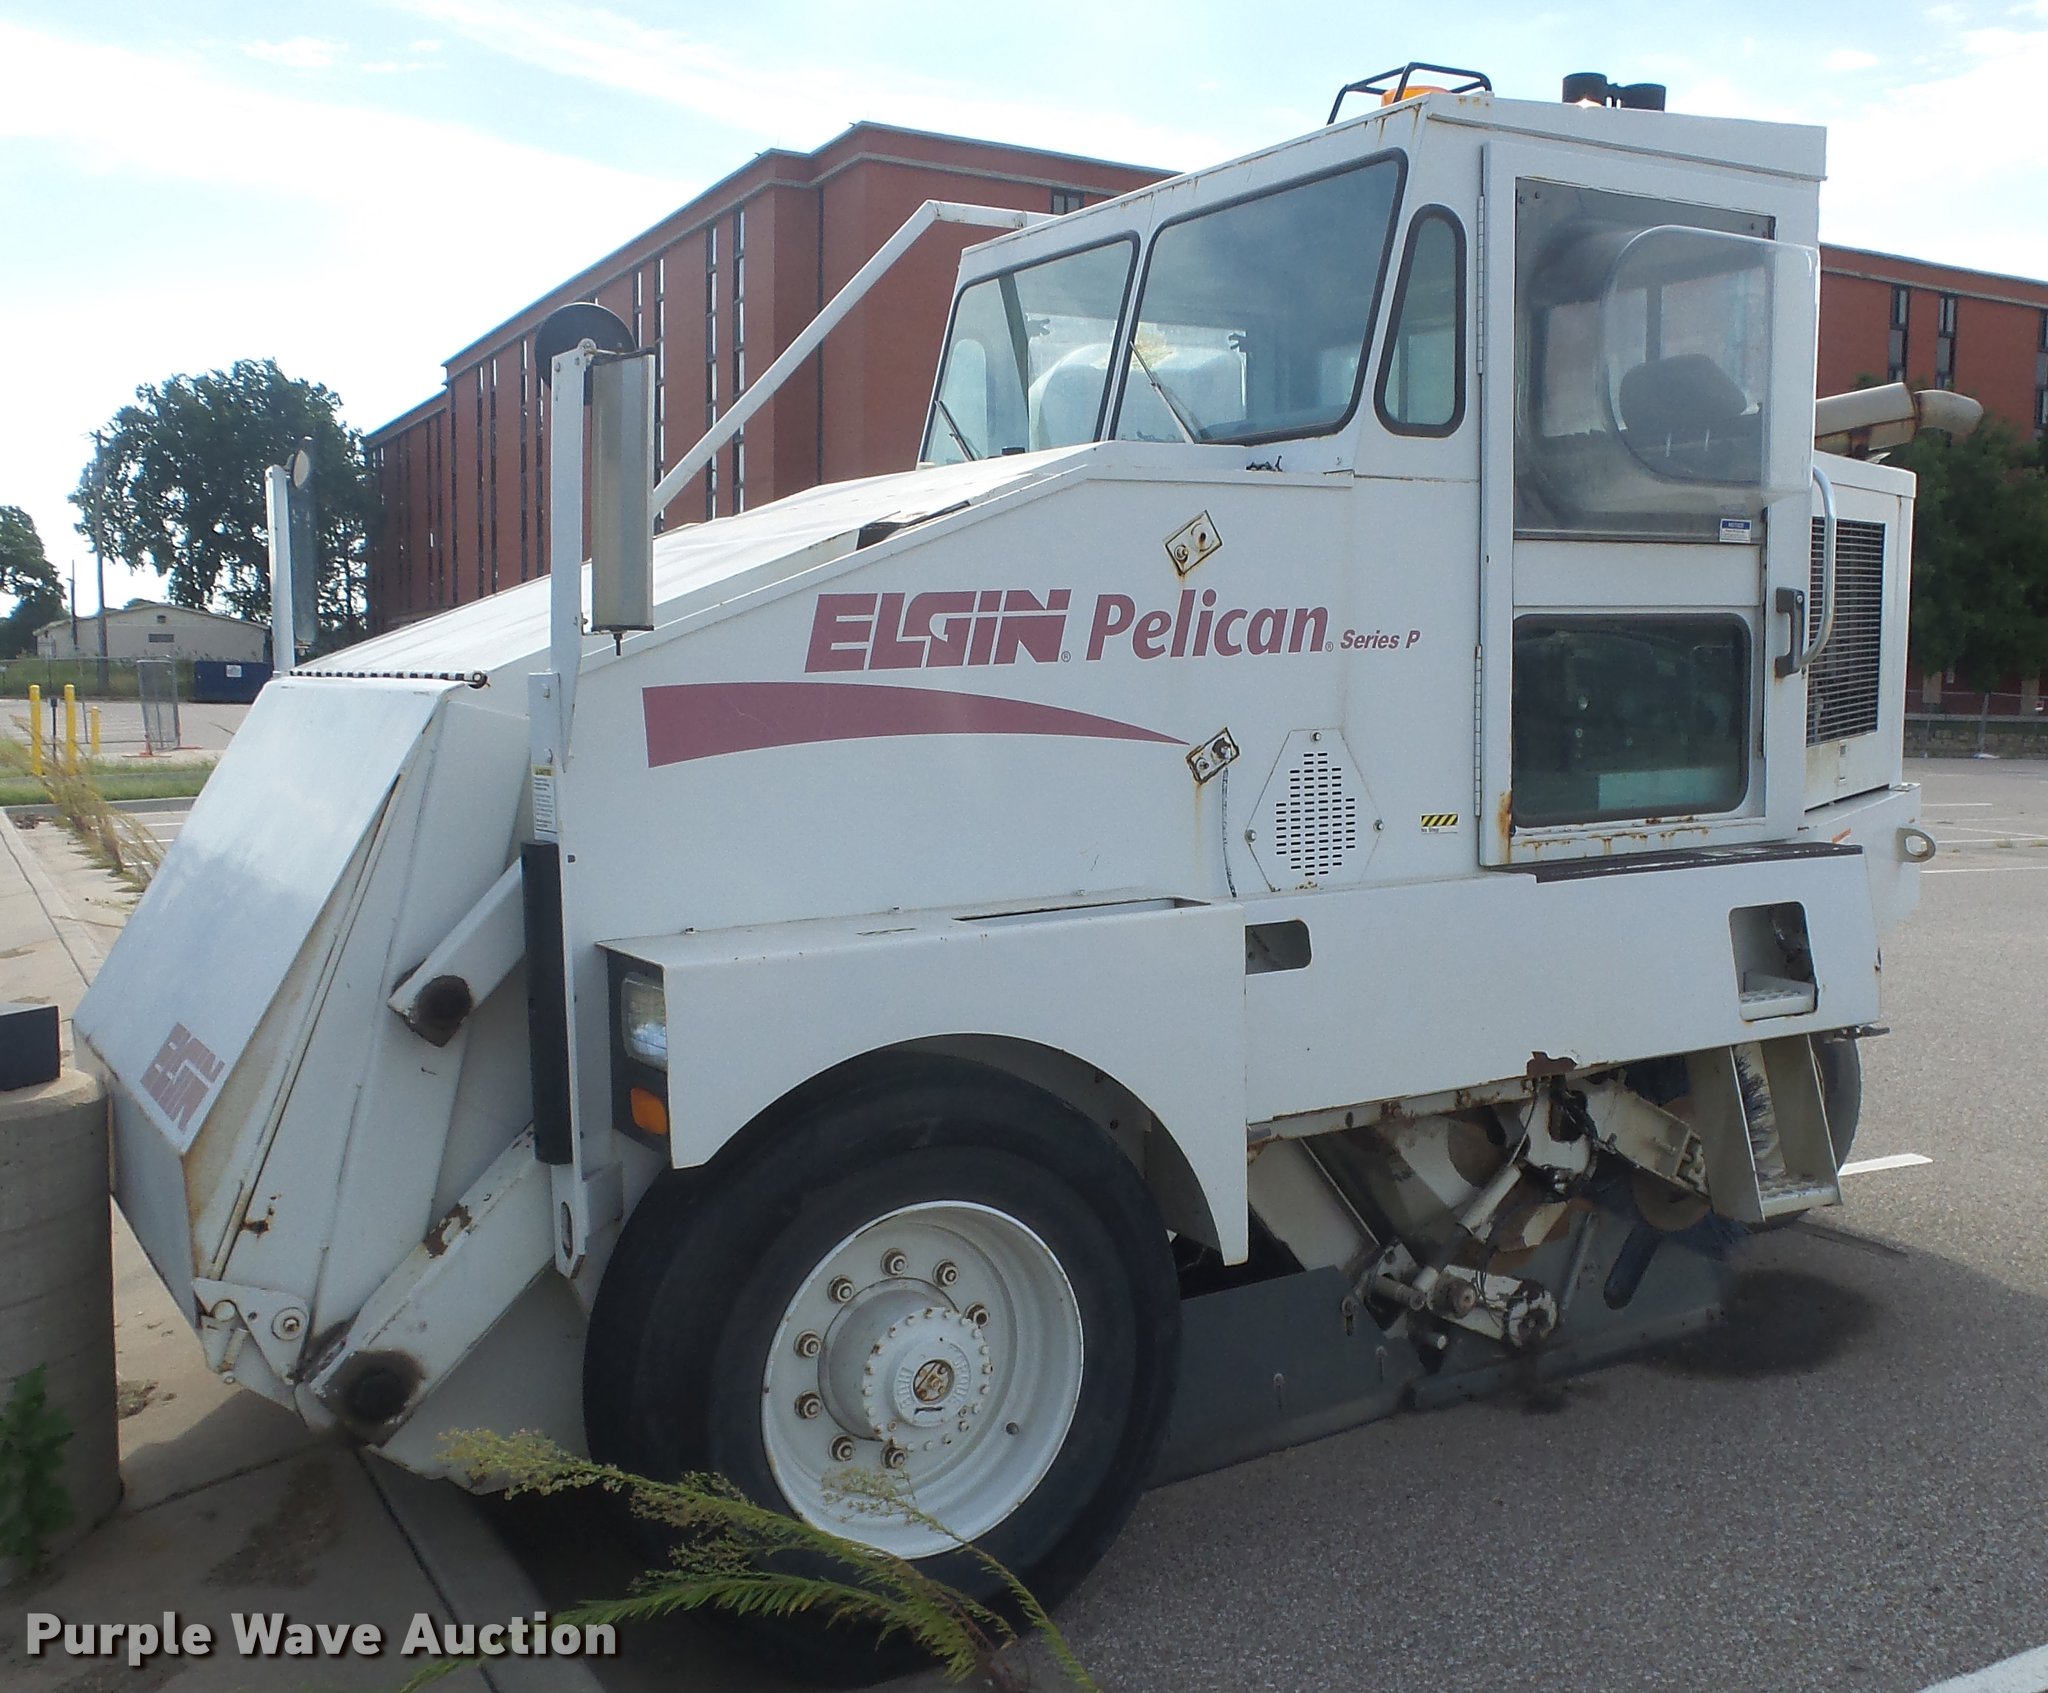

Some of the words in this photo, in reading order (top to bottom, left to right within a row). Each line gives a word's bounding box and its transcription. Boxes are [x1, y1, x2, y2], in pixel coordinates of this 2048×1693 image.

[804, 588, 1073, 673] ELGIN
[1085, 588, 1328, 661] Pelican
[1340, 629, 1400, 650] Series
[1405, 629, 1421, 649] P
